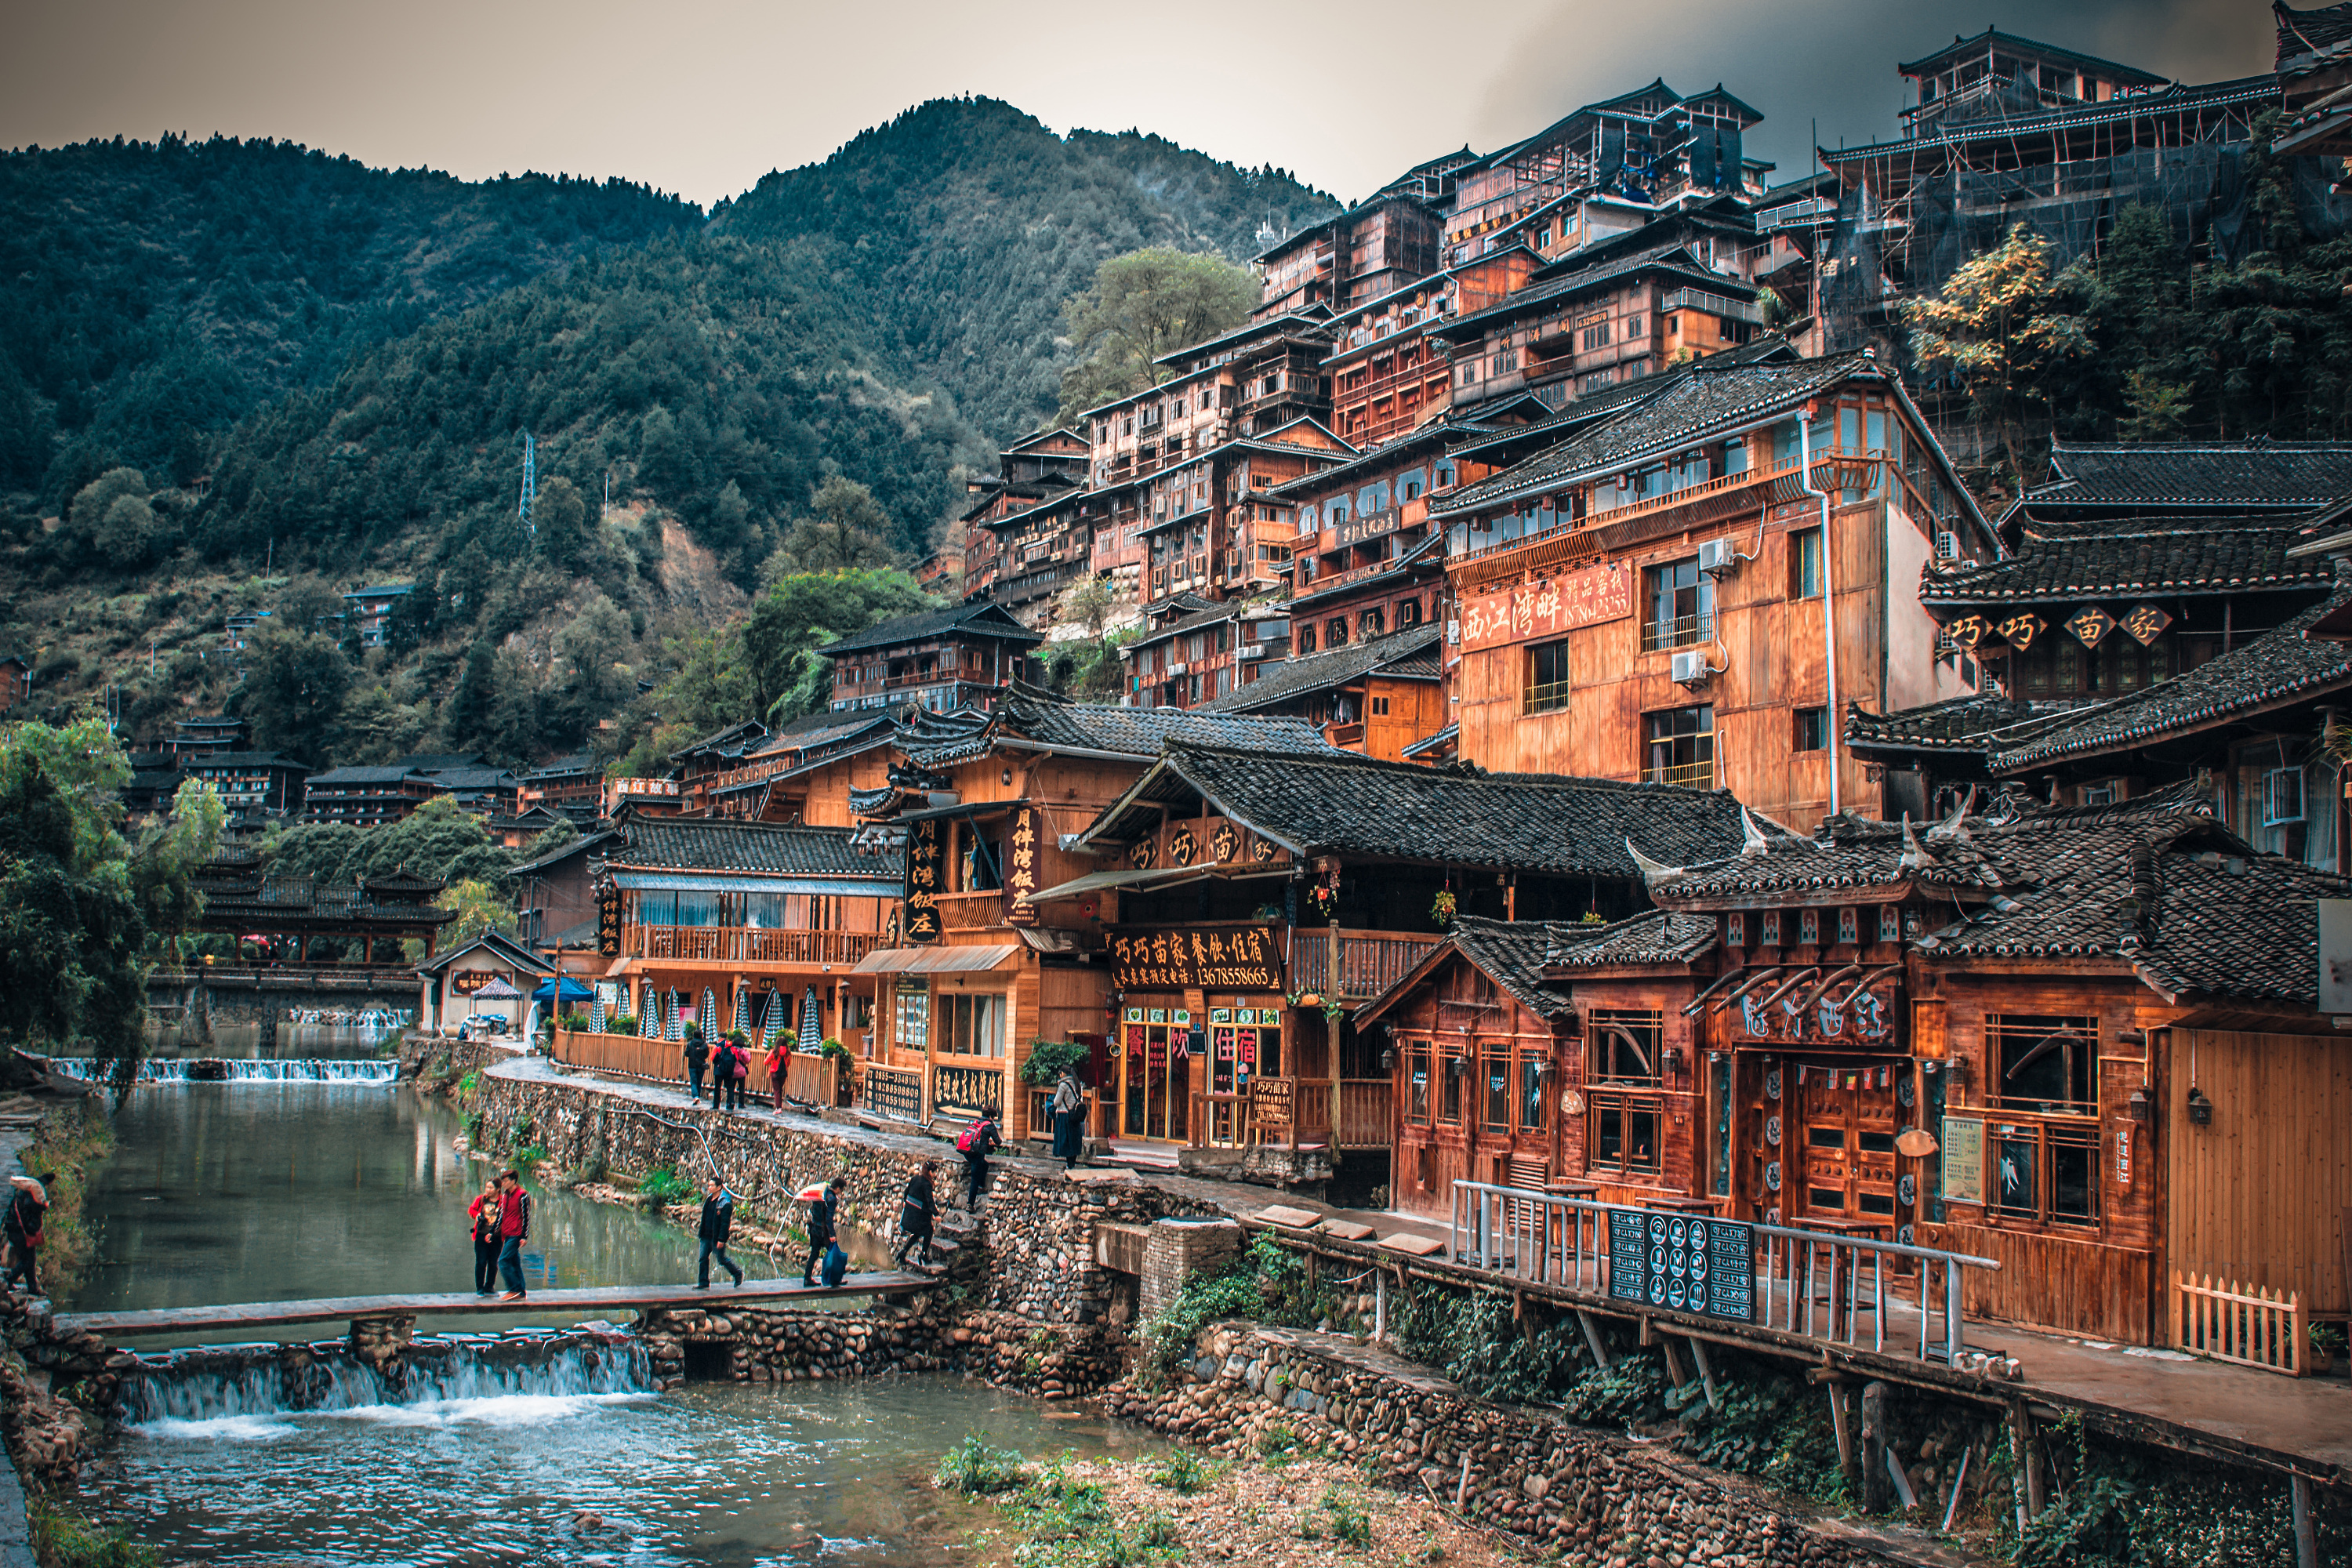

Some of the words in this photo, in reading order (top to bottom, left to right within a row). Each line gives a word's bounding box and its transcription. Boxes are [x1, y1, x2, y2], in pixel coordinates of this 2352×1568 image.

[1566, 568, 1624, 603] 精品客栈
[1463, 582, 1562, 641] 西江湾畔
[1951, 607, 2160, 644] 巧巧苗家
[616, 779, 679, 795] 西江故事
